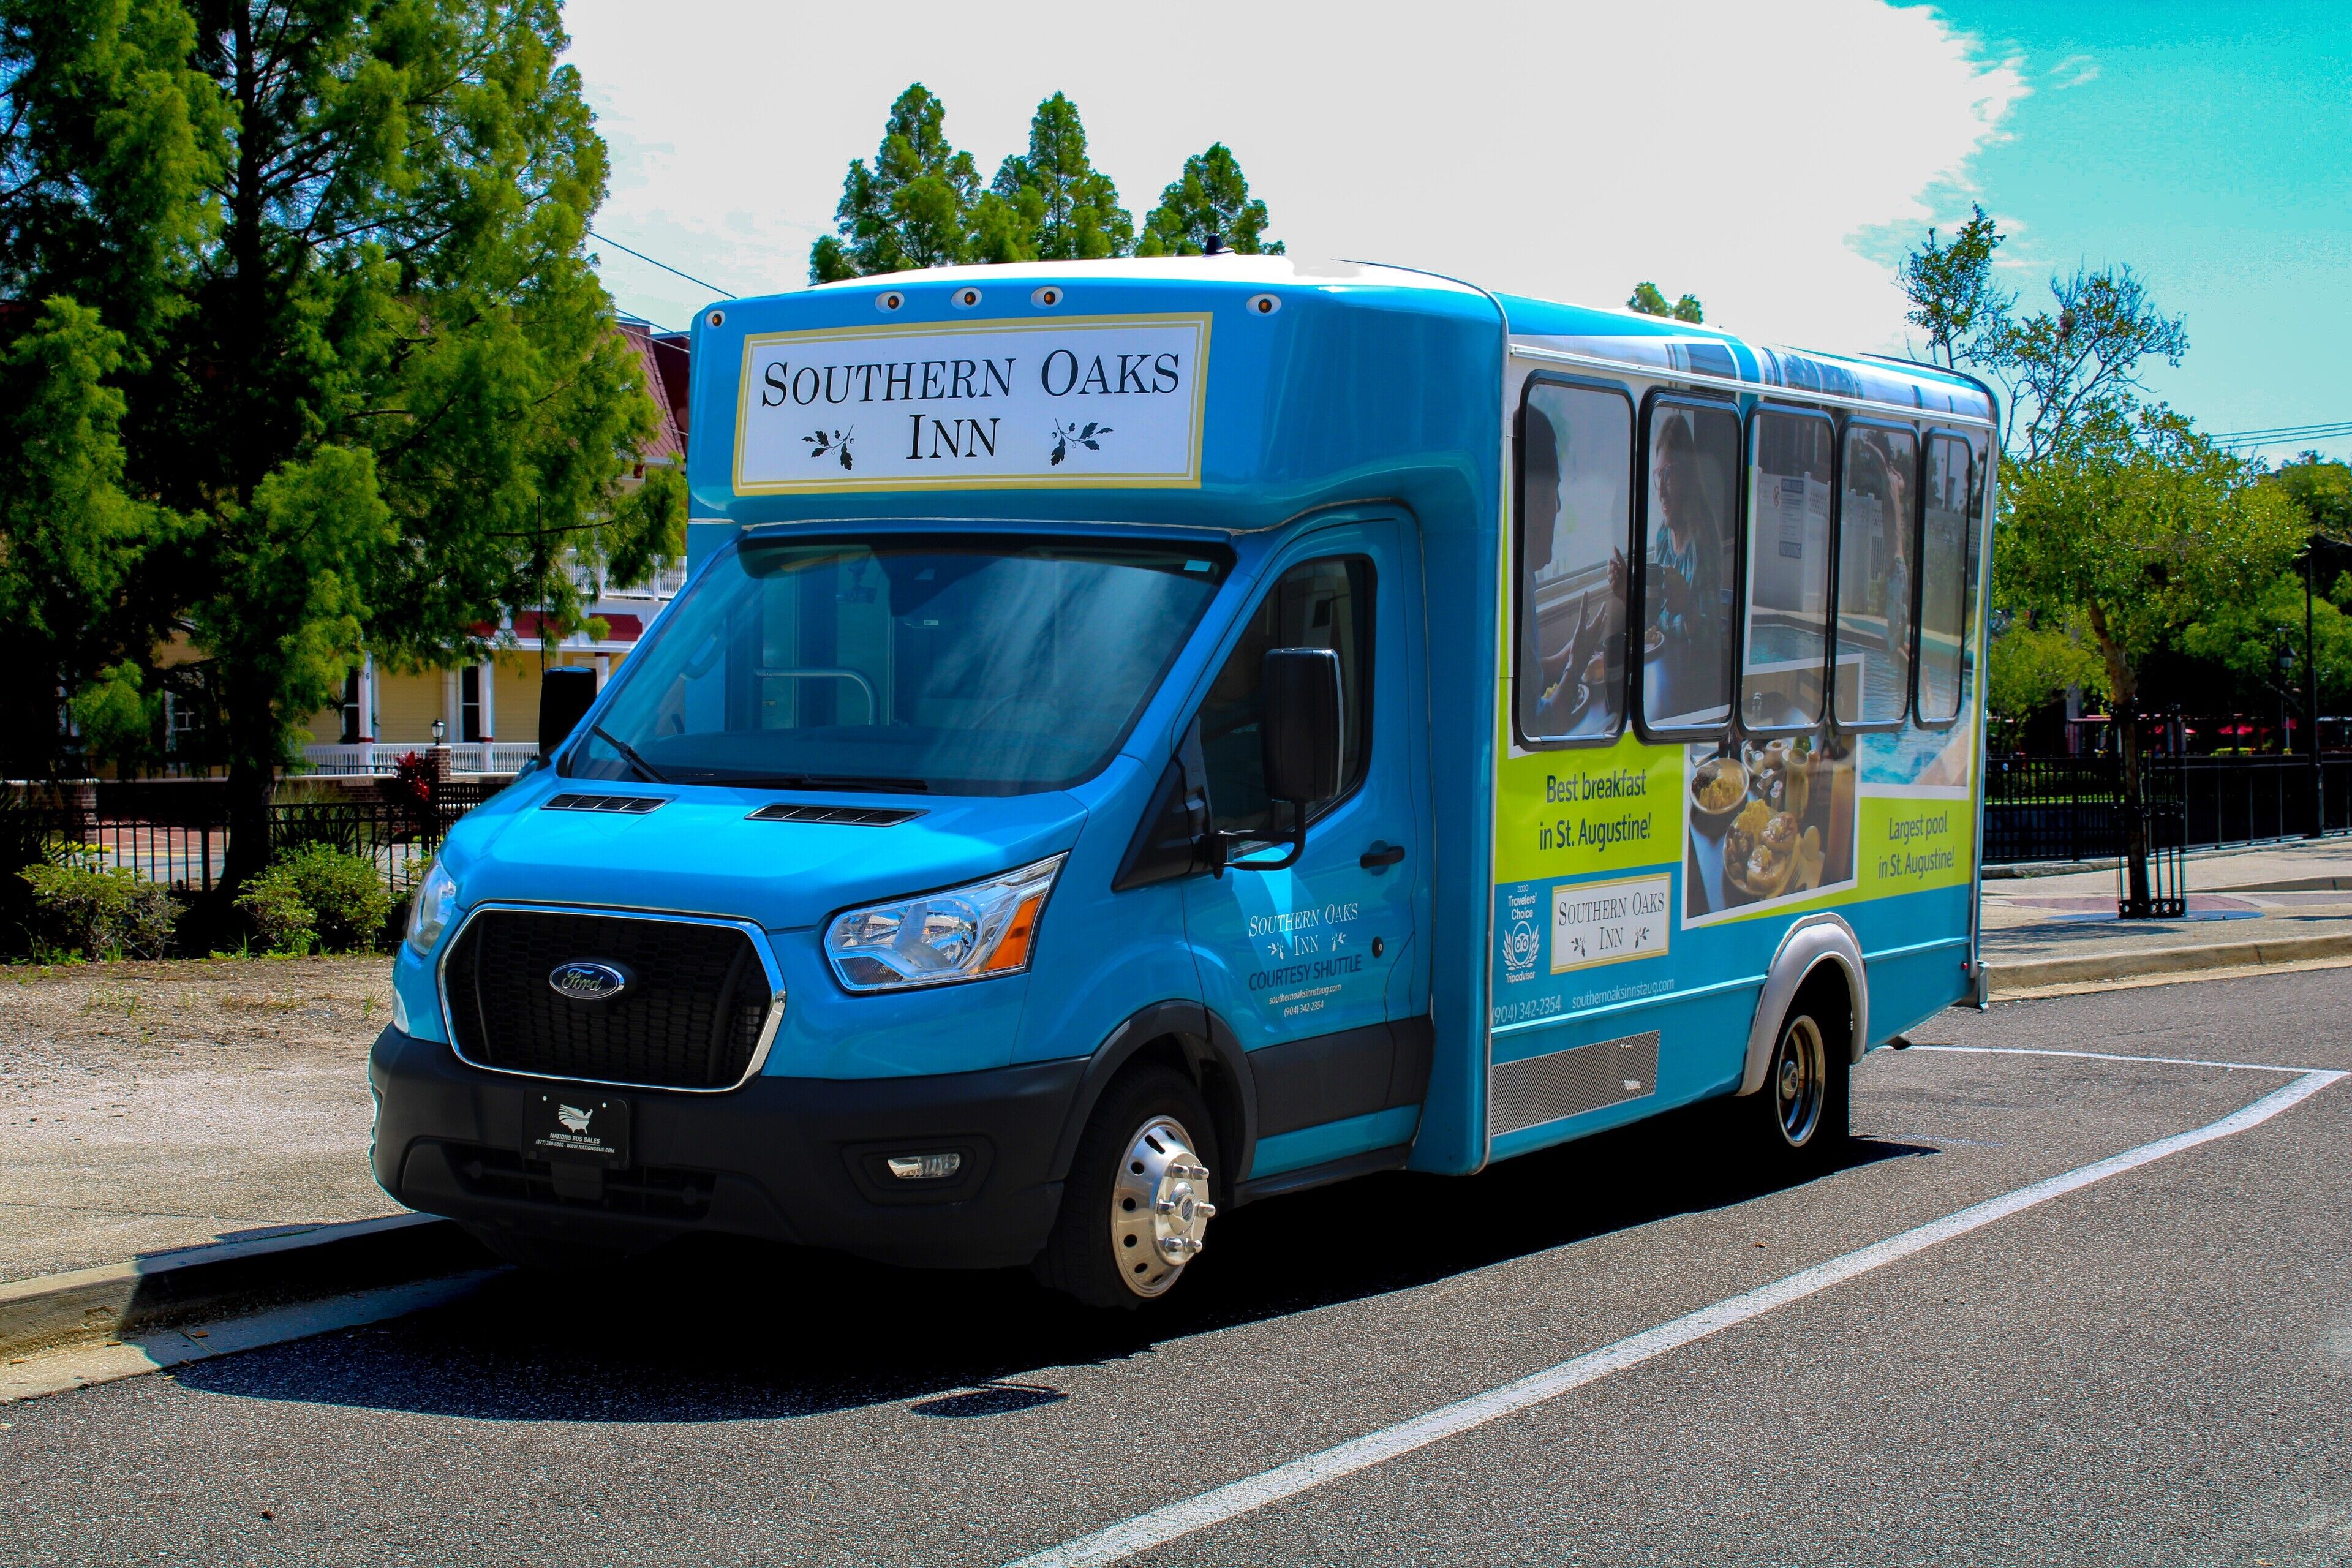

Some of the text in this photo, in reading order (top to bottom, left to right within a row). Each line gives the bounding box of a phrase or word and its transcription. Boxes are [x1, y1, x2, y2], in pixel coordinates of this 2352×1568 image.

[761, 349, 1180, 408] SOUTHERN OAKS
[906, 413, 1001, 461] INN
[1547, 769, 1646, 804] Best breakfast
[1539, 812, 1651, 852] in St. Augustine!
[1889, 810, 1948, 845] Largest pool
[1879, 846, 1954, 880] in St. Augustine!
[1517, 884, 1529, 893] 2020
[1248, 902, 1359, 937] SOUTHERN OAKS
[1511, 907, 1534, 920] Choice
[1559, 892, 1665, 926] SOUTHERN OAKS
[1293, 935, 1319, 956] INN
[1599, 927, 1624, 950] INN
[562, 968, 604, 992] Ford
[1249, 954, 1362, 991] COURTESY SHUTTLE
[1506, 970, 1536, 984] Tripadvisor
[1269, 983, 1341, 1005] southernoaksinnstaug.com
[1572, 978, 1675, 1009] southernoaksinnstaug.com
[1284, 1005, 1299, 1017] (904)
[1491, 995, 1562, 1027] (904) 342-2354
[567, 1143, 615, 1153] WWW.NATIONSBUS.COM
